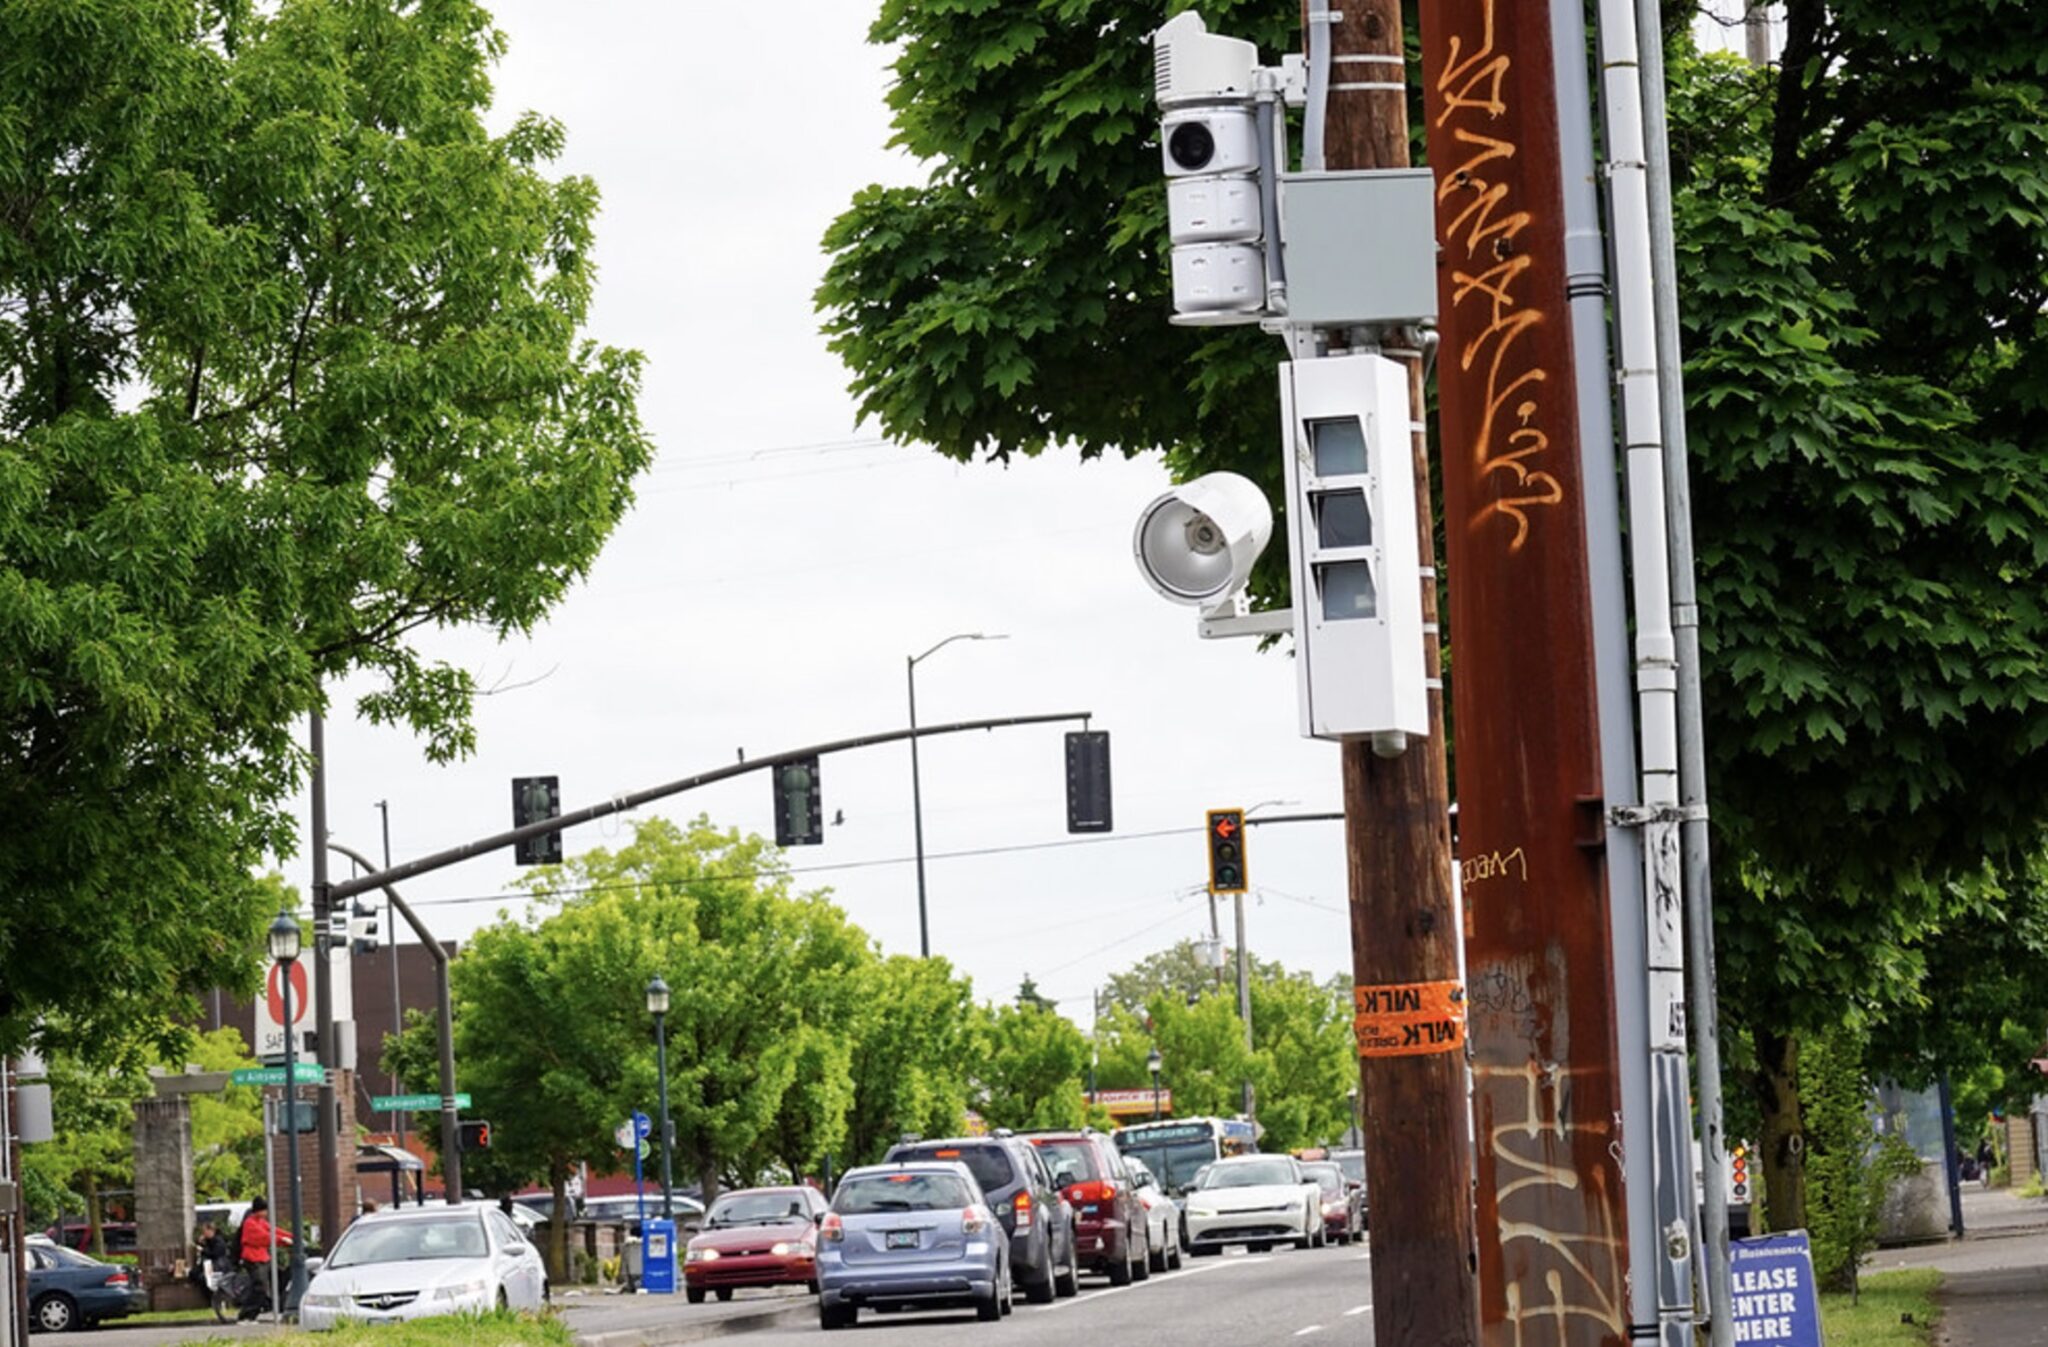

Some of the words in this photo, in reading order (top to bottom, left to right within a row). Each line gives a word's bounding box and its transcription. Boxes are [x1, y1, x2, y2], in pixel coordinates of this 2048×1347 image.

[1364, 988, 1420, 1013] MLK
[1402, 1020, 1456, 1046] MLK
[1733, 1267, 1798, 1293] LEASE
[1734, 1317, 1793, 1341] HERE
